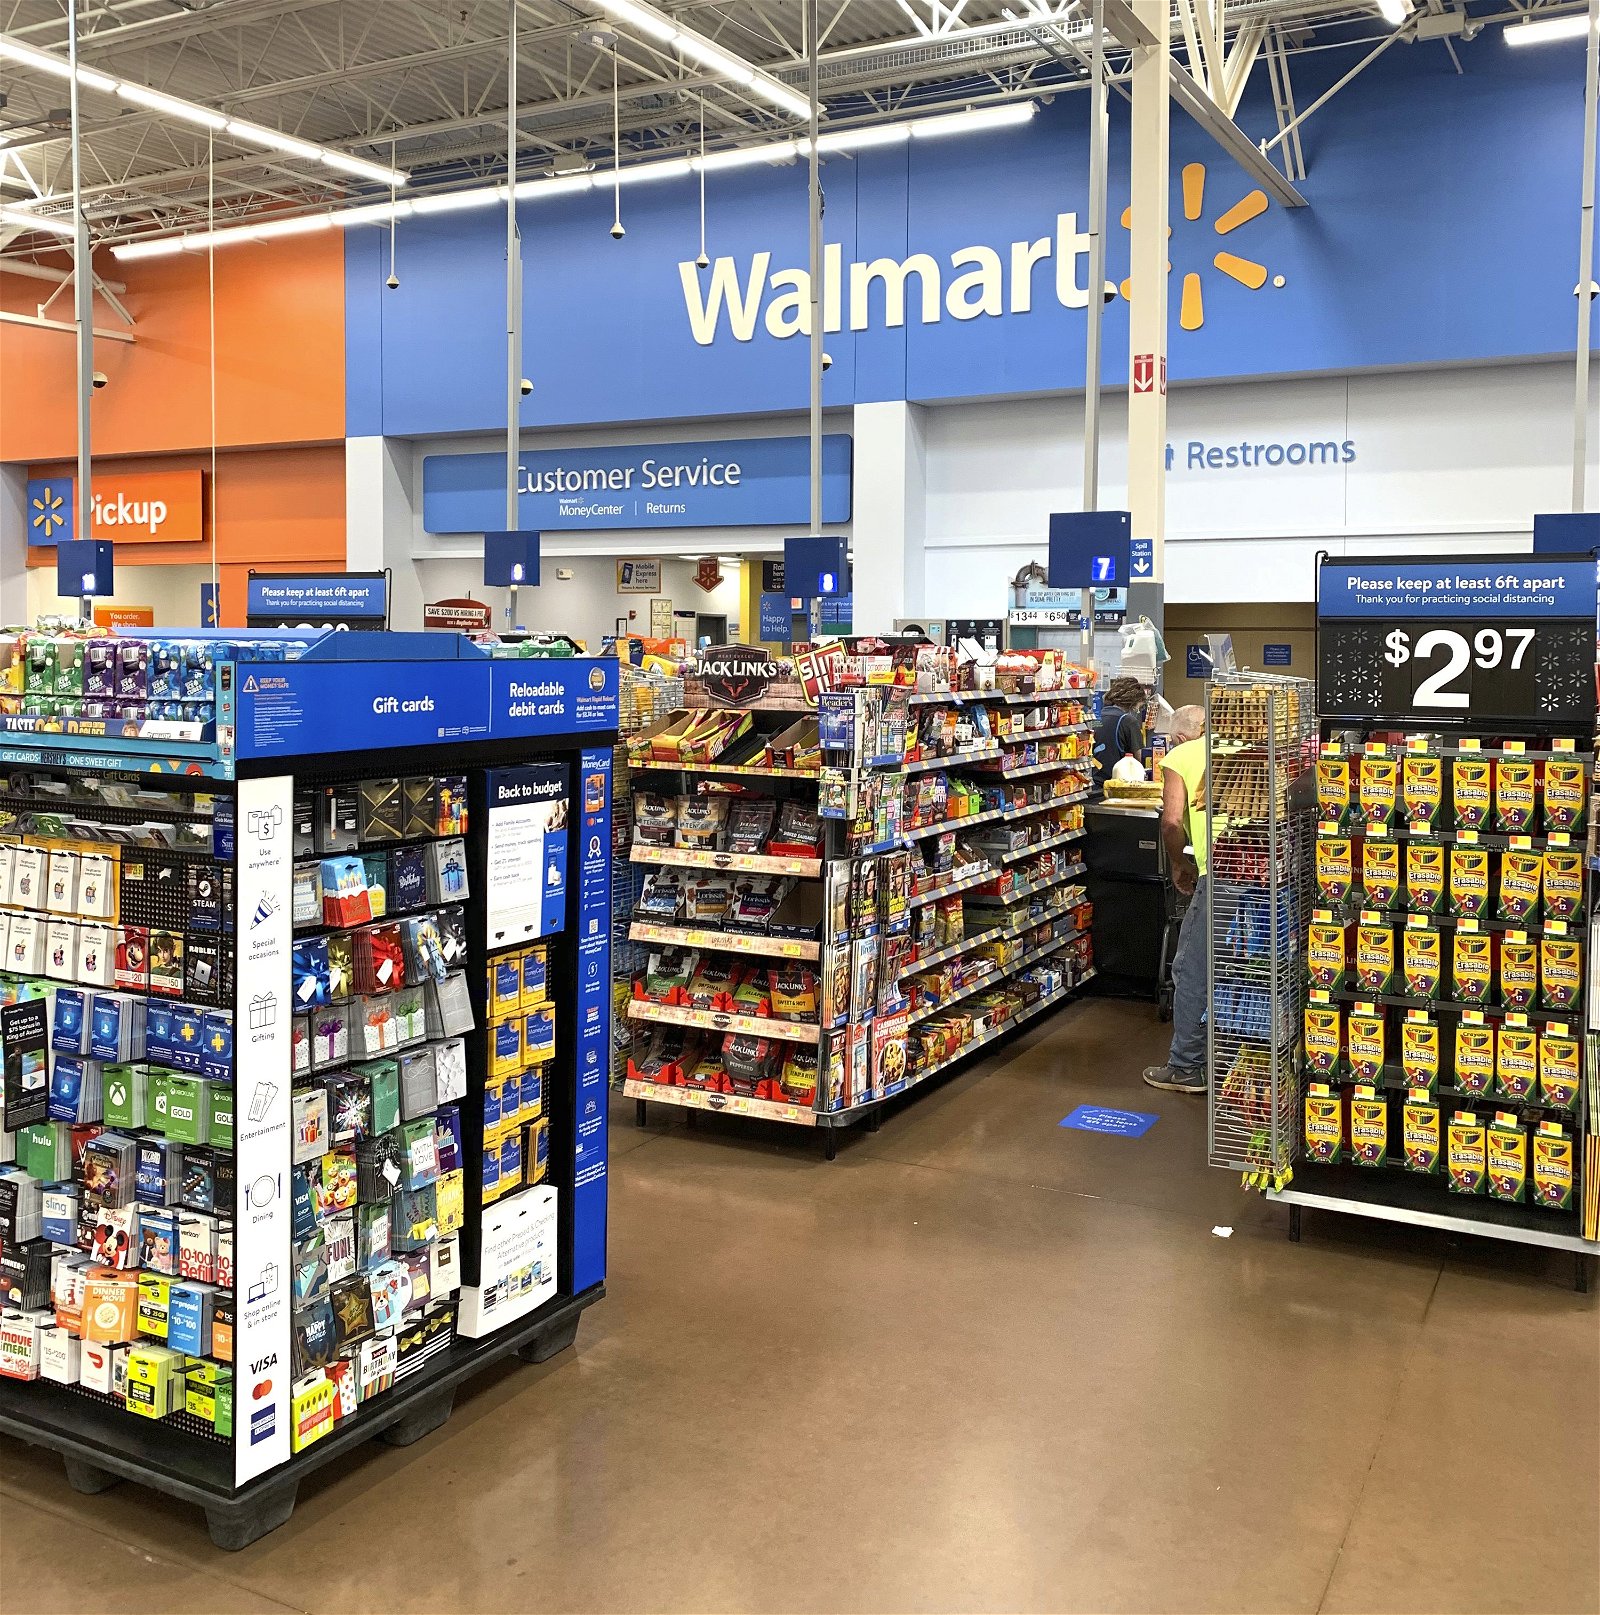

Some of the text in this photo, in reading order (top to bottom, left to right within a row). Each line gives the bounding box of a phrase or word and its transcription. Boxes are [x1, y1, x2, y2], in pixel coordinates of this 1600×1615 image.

[679, 213, 1092, 346] Walmart
[1187, 440, 1356, 469] Restrooms
[517, 458, 741, 493] Customer Service
[559, 504, 623, 518] MoneyCenter
[646, 501, 686, 514] Returns
[635, 570, 657, 579] Express
[1097, 557, 1110, 580] 7
[1347, 575, 1565, 593] Please keep at least 6ft apart
[262, 586, 369, 598] Please keep at least 6ft apart
[299, 599, 322, 607] practicing
[339, 599, 364, 607] distancing
[1356, 593, 1554, 605] Thank you for practicing social distancing
[110, 612, 122, 620] You
[763, 615, 785, 623] Happy
[771, 625, 789, 633] Help.
[694, 660, 777, 677] JACK LINK'S
[509, 681, 565, 697] Reloadable
[373, 695, 434, 714] Gift cards
[509, 700, 565, 717] debit cards
[822, 698, 853, 708] Reader's
[6, 718, 35, 731] TASTE
[3, 752, 16, 760] GIFT
[17, 752, 38, 762] CARDS
[69, 756, 84, 765] ONE
[85, 757, 106, 767] SWEET
[108, 758, 122, 768] GIFT
[582, 758, 610, 769] MoneyCard
[67, 768, 140, 781] Walmart Gift Cards
[498, 781, 562, 799] Back to budget
[1406, 783, 1439, 794] Erasable
[1419, 807, 1426, 815] 12
[259, 848, 271, 856] Use
[249, 858, 280, 869] anywhere
[193, 900, 216, 909] STEAM
[252, 938, 276, 949] Special
[189, 945, 217, 956] ROBLOX
[249, 949, 279, 960] occasions
[1503, 970, 1536, 982] Erasable
[775, 981, 789, 990] JACK
[1515, 994, 1522, 1002] 12
[19, 1022, 34, 1031] bonus
[876, 1016, 907, 1031] CASSEROLES
[26, 1027, 43, 1035] Avalon
[251, 1032, 275, 1043] Gifting
[172, 1108, 191, 1118] GOLD
[240, 1121, 286, 1142] Entertainment
[1307, 1123, 1339, 1133] Erasable
[32, 1133, 51, 1146] hulu
[413, 1142, 432, 1155] WITH
[184, 1155, 212, 1167] MINECRAFT
[414, 1152, 433, 1166] LOVE
[1536, 1164, 1570, 1176] Erasable
[295, 1192, 310, 1206] VISA
[46, 1197, 67, 1215] sling
[104, 1209, 127, 1227] Disney
[252, 1211, 274, 1224] Dining
[181, 1230, 199, 1239] verizon
[325, 1236, 350, 1265] FUN!
[93, 1287, 125, 1296] DINNER
[102, 1294, 126, 1302] MOVIE
[178, 1301, 199, 1312] prepaid
[243, 1299, 281, 1320] Shop online
[247, 1311, 278, 1328] & in store
[306, 1318, 326, 1338] HAPPY
[1, 1331, 32, 1347] MOVIE
[44, 1330, 57, 1339] Uber
[250, 1353, 278, 1375] VISA
[363, 1353, 396, 1375] BIRTHDAY
